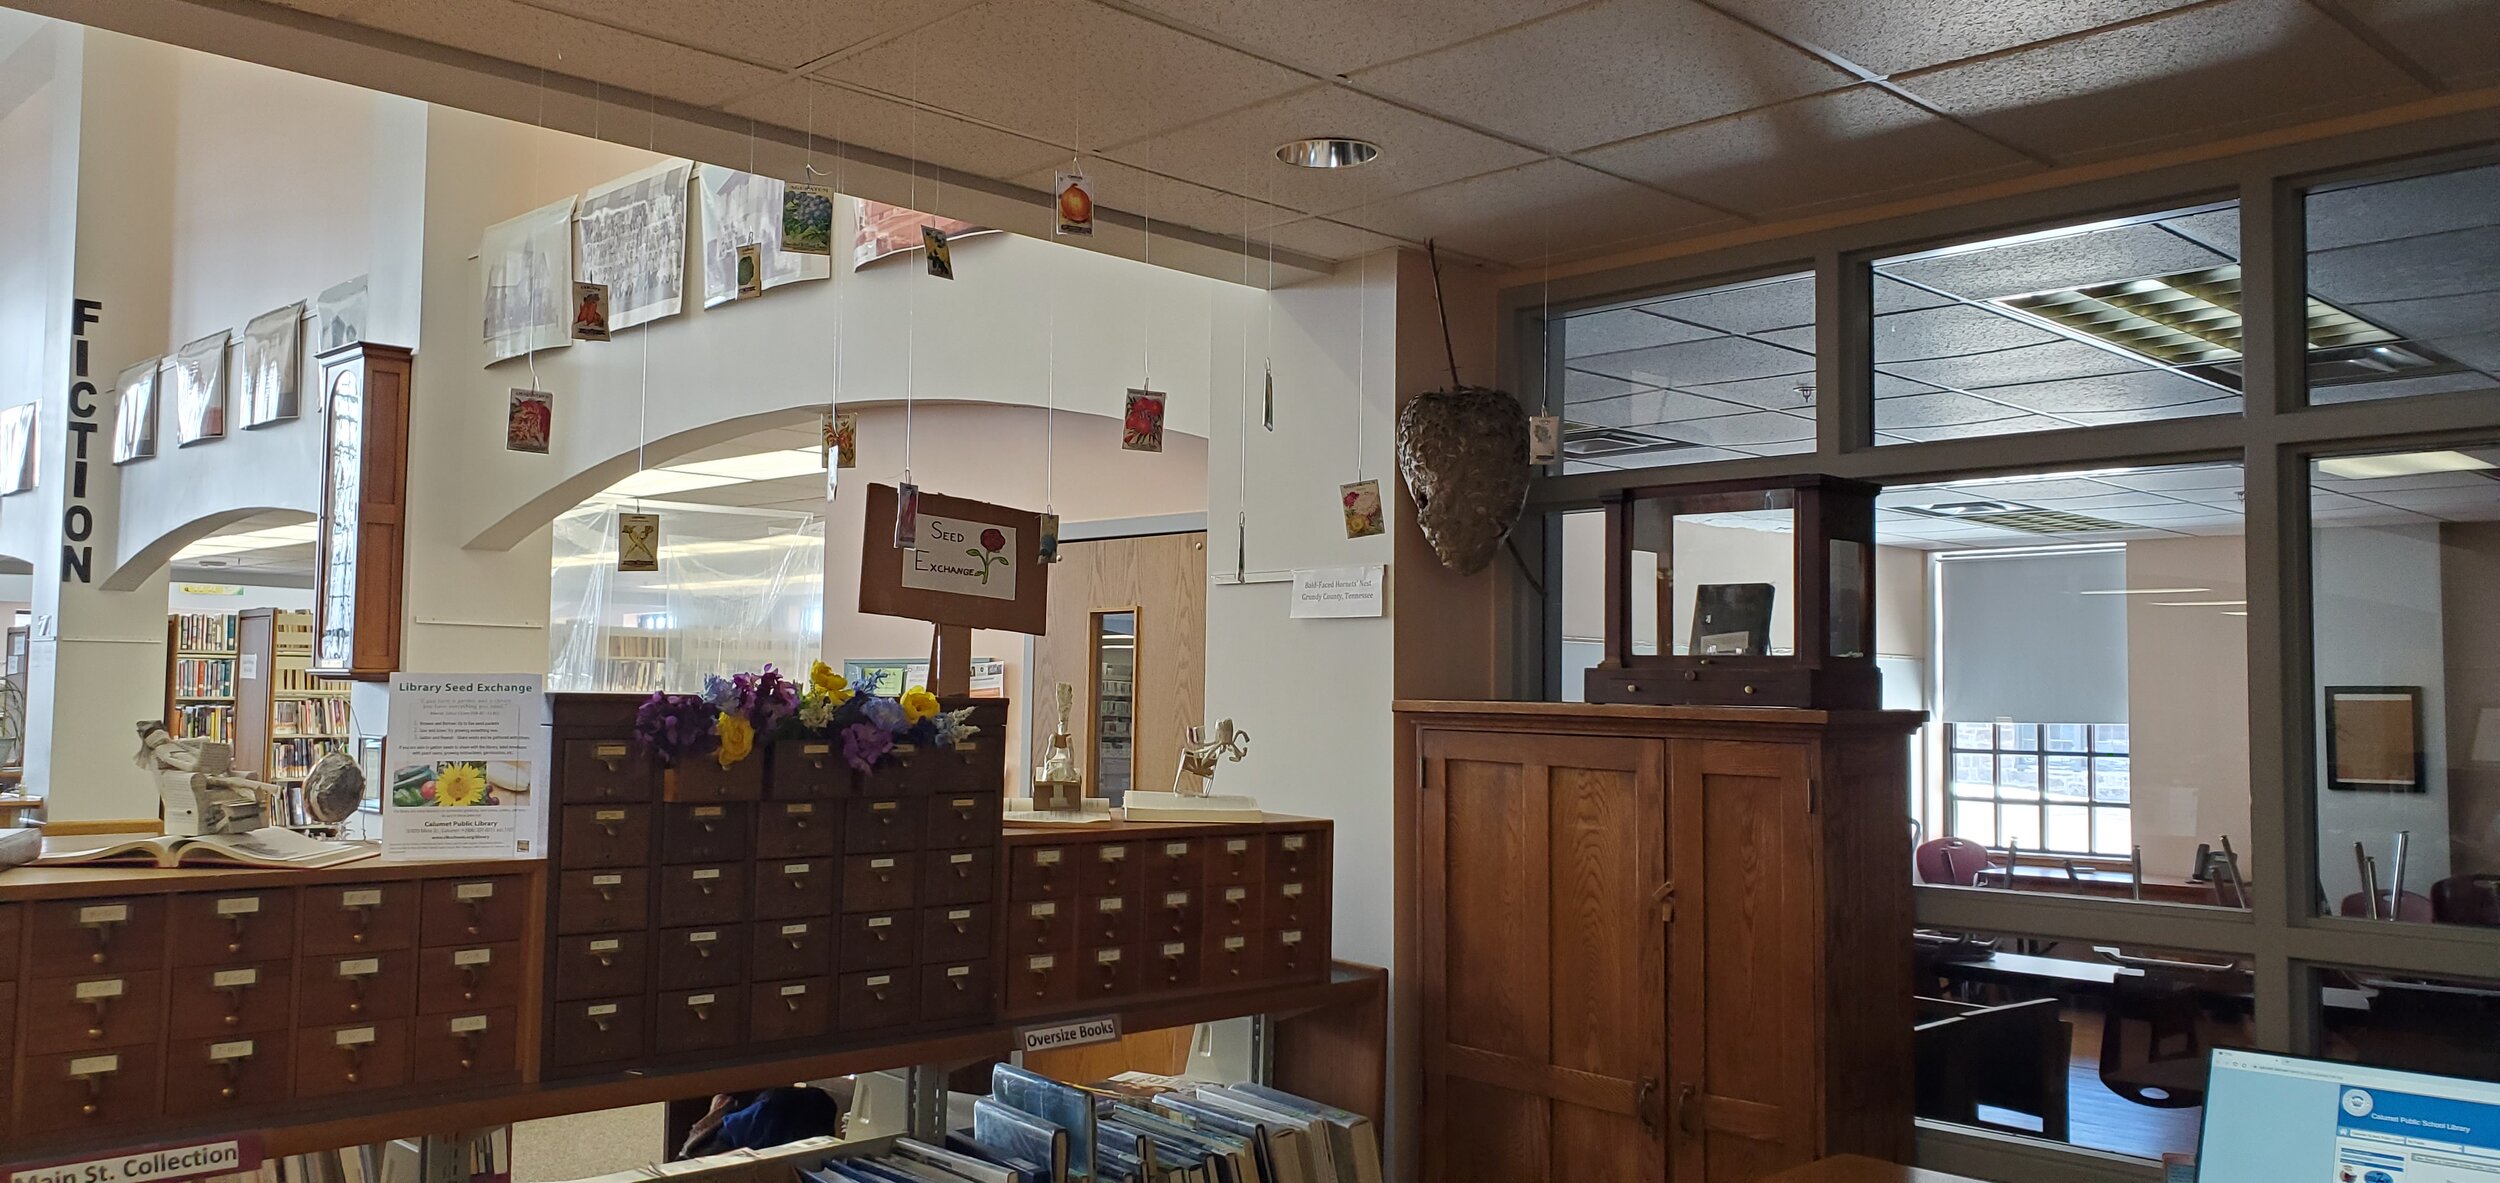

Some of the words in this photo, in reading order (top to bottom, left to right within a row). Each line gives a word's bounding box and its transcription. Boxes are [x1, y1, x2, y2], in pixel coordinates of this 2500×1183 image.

[62, 298, 102, 583] FICTION
[1304, 581, 1334, 589] Bald-Faced
[1301, 593, 1321, 602] Grundy
[1323, 593, 1344, 601] County,
[1345, 592, 1374, 600] Tennessee
[399, 683, 442, 694] Library
[445, 683, 473, 692] Seed
[477, 683, 533, 694] Exchange
[474, 820, 499, 828] Library
[1027, 1028, 1077, 1047] Oversize
[1079, 1022, 1114, 1039] Books
[2370, 1112, 2399, 1122] Calumet
[2400, 1116, 2421, 1126] Public
[2422, 1119, 2446, 1129] School
[2446, 1123, 2471, 1134] Library
[84, 1165, 115, 1183] St.
[123, 1147, 238, 1178] Collection
